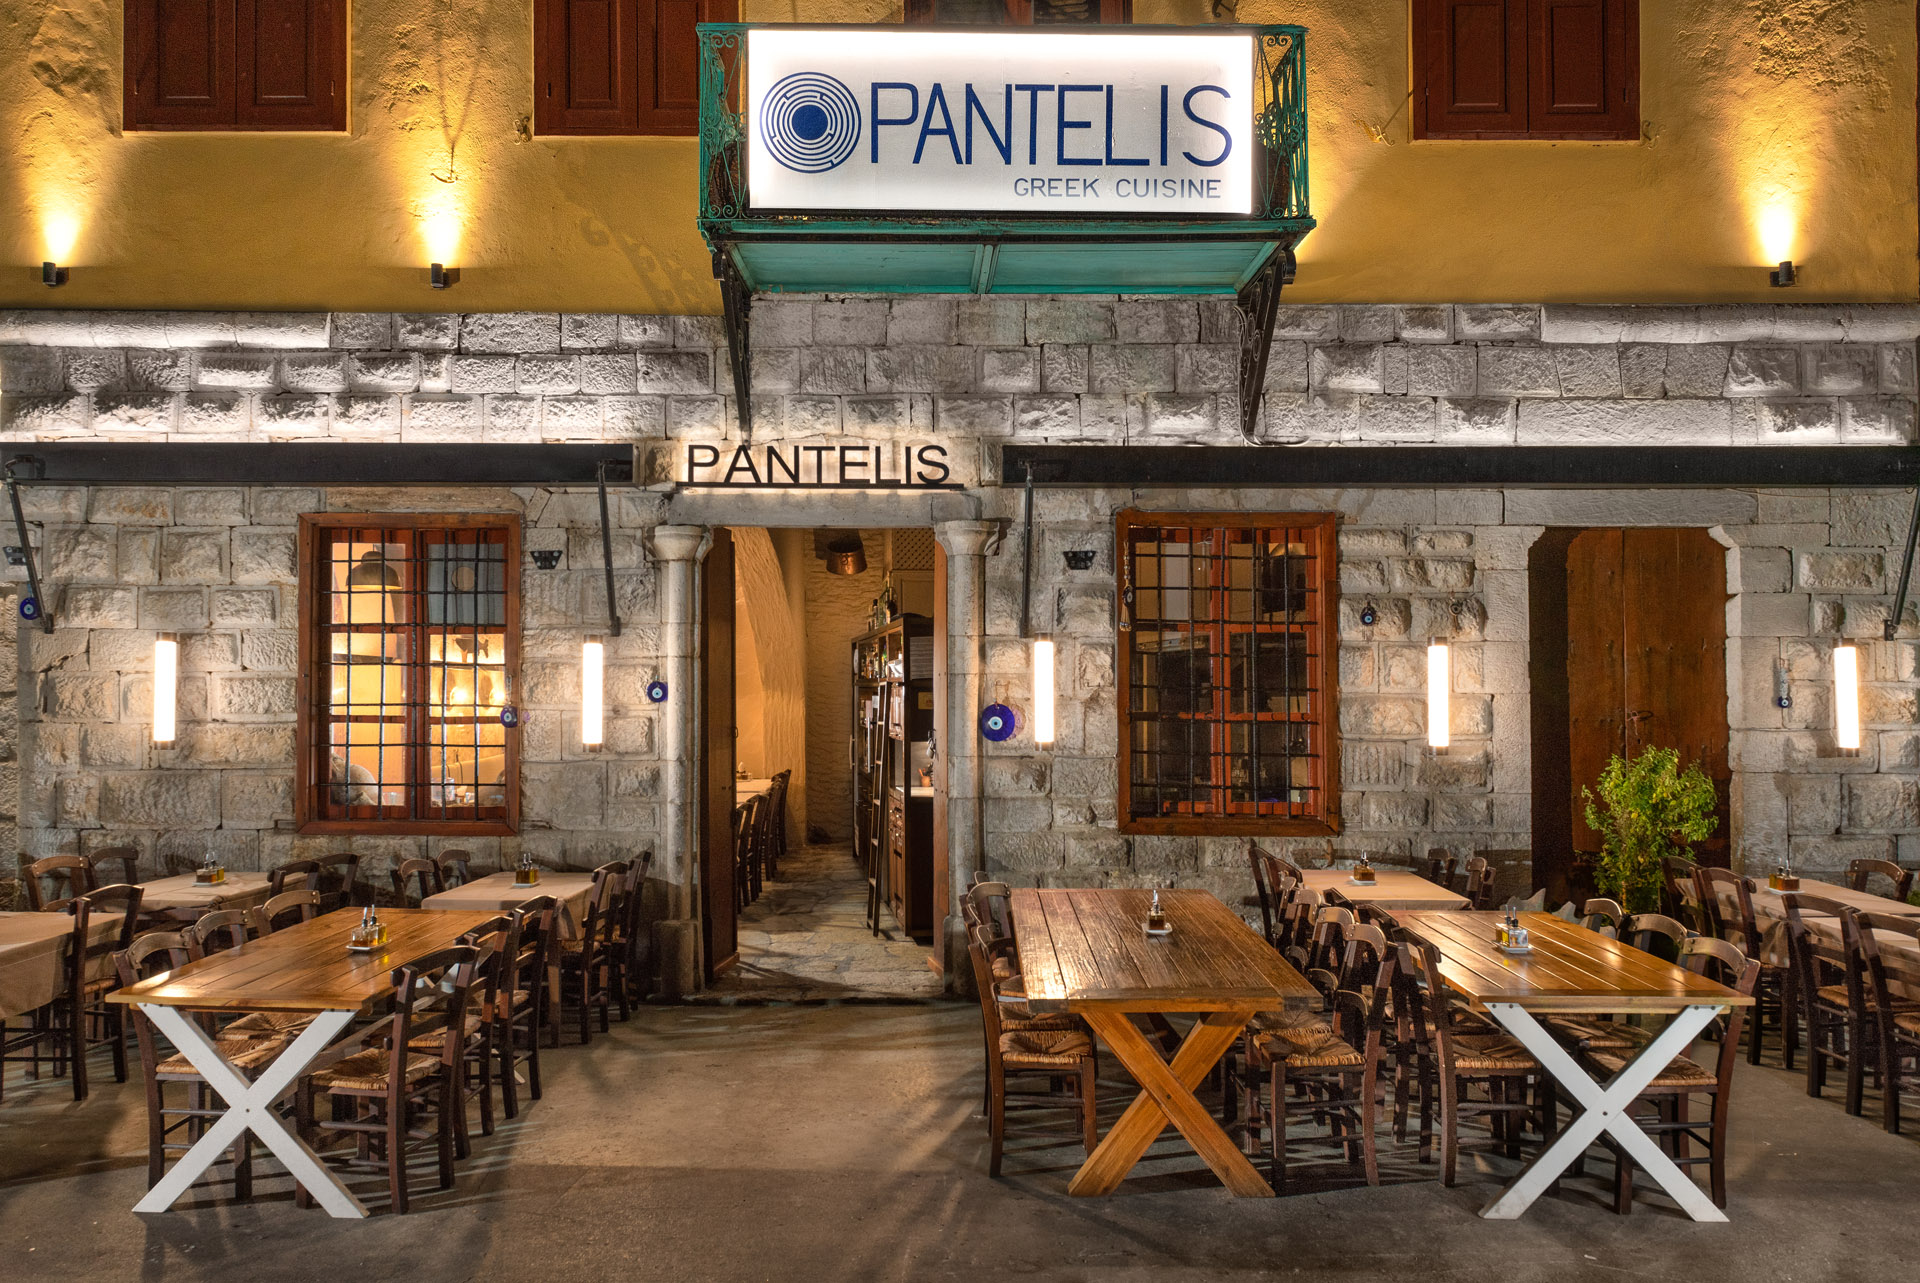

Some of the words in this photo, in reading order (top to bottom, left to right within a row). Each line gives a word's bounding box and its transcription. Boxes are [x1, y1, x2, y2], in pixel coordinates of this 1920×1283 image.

[871, 83, 1232, 166] PANTELIS
[1014, 177, 1099, 198] GREEK
[1115, 178, 1221, 199] CUISINE
[687, 444, 951, 484] PANTELIS
